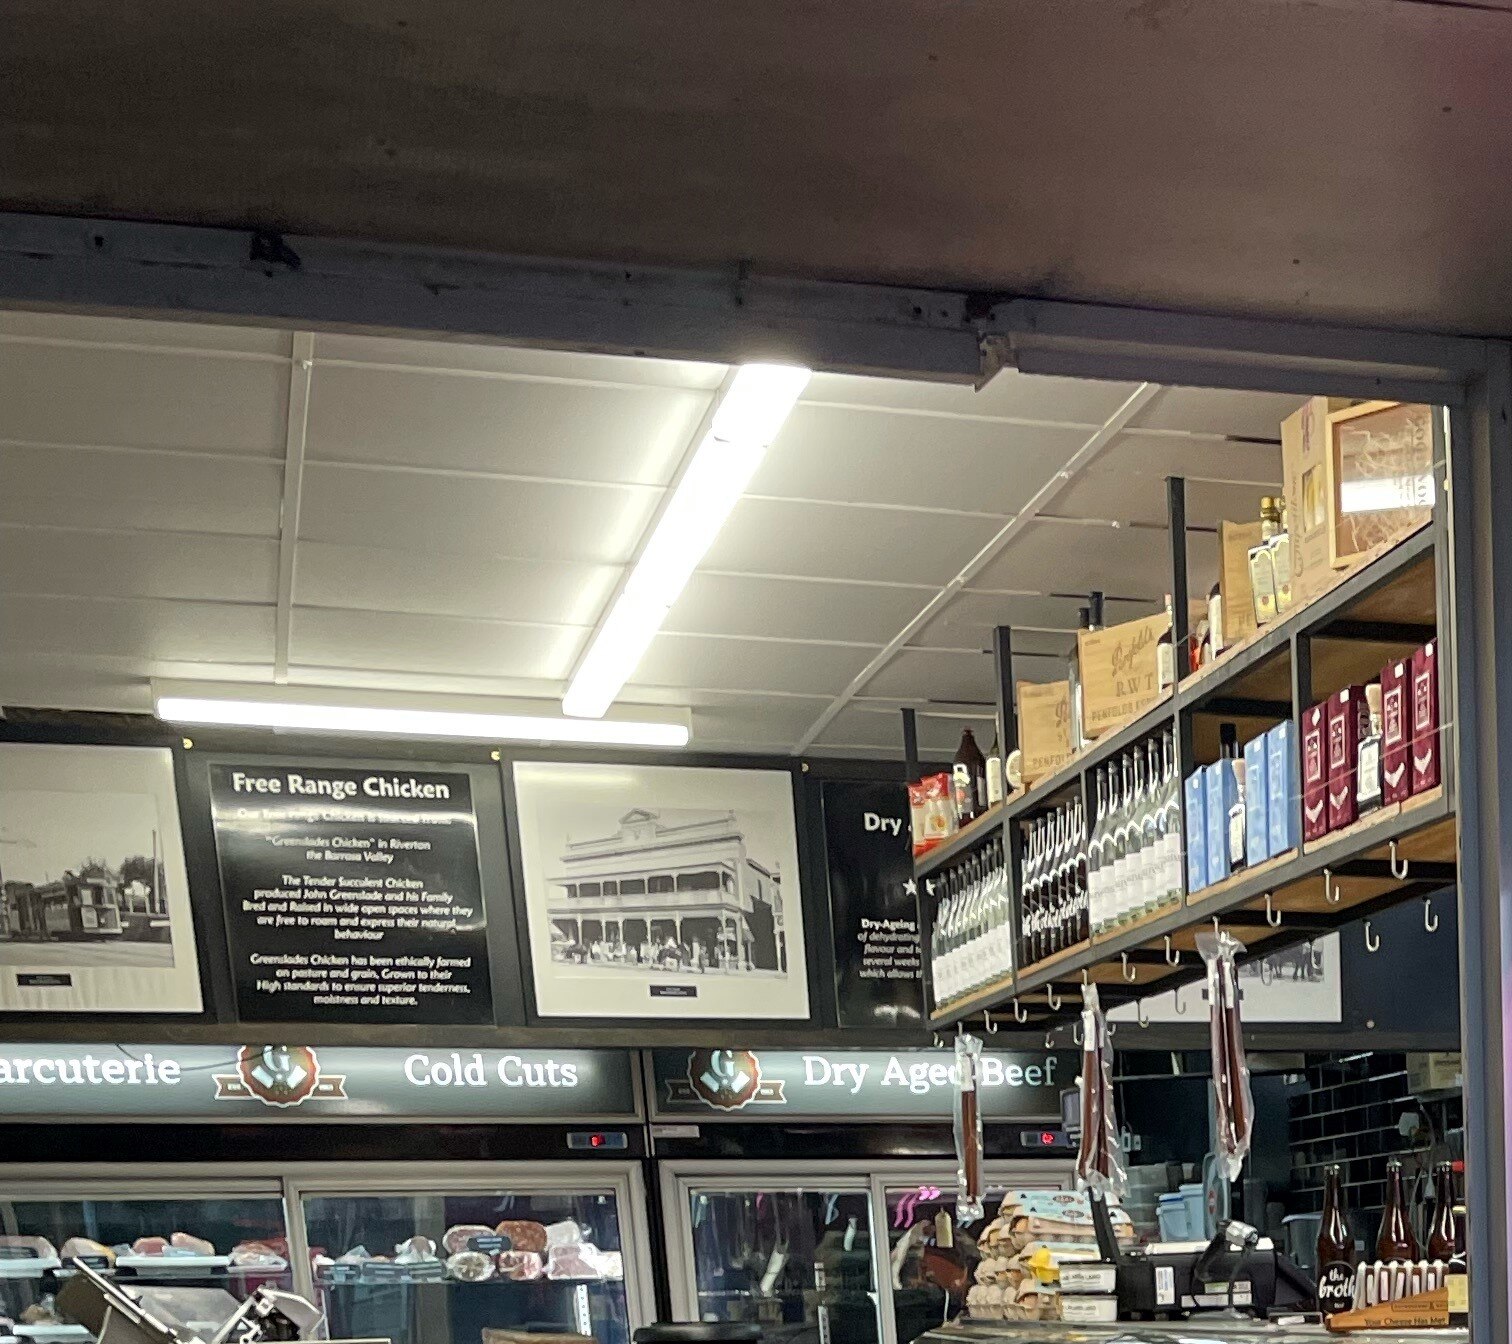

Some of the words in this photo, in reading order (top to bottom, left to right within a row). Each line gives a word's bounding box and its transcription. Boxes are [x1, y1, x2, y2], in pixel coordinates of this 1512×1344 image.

[232, 772, 281, 793] Free
[287, 774, 358, 800] Range
[363, 776, 451, 799] Chicken
[863, 811, 902, 837] Dry
[378, 838, 388, 848] in
[390, 839, 431, 850] Riverton
[306, 850, 322, 860] the
[364, 852, 394, 864] Valley
[282, 875, 301, 886] The
[303, 876, 336, 887] Tender
[338, 877, 383, 888] Succulent
[385, 877, 424, 889] Chicken
[254, 889, 301, 900] produced
[303, 889, 327, 900] John
[385, 891, 403, 902] and
[406, 892, 419, 902] his
[421, 892, 453, 905] Family
[242, 900, 266, 911] Bred
[268, 901, 287, 912] and
[289, 901, 322, 912] Raised
[323, 902, 333, 913] in
[335, 903, 359, 914] wide
[361, 904, 386, 916] open
[388, 905, 418, 917] spaces
[420, 905, 451, 916] where
[452, 905, 473, 918] they
[257, 916, 274, 926] are
[275, 914, 296, 928] free
[298, 916, 309, 927] to
[310, 917, 338, 927] roam
[339, 917, 359, 927] and
[360, 918, 394, 929] express
[396, 917, 419, 928] their
[421, 918, 456, 929] natural
[861, 918, 915, 931] Dry-Ageing
[334, 929, 384, 940] behaviour
[857, 933, 867, 943] of
[863, 944, 894, 955] flavour
[896, 944, 914, 955] and
[310, 954, 349, 966] Chicken
[351, 955, 367, 966] has
[369, 955, 394, 967] been
[395, 955, 435, 968] ethically
[863, 956, 893, 967] several
[276, 969, 290, 978] on
[292, 968, 328, 980] pasture
[329, 969, 349, 979] and
[381, 969, 415, 980] Grown
[417, 970, 428, 980] to
[430, 970, 453, 981] their
[859, 969, 885, 980] which
[887, 969, 914, 979] allows
[256, 980, 281, 994] High
[283, 981, 329, 992] standards
[332, 982, 343, 992] to
[345, 982, 376, 993] ensure
[378, 983, 416, 995] superior
[313, 995, 359, 1005] moistness
[360, 996, 380, 1006] and
[403, 1053, 487, 1087] Cold
[497, 1054, 579, 1088] Cuts
[802, 1055, 870, 1094] Dry
[979, 1057, 1057, 1087] Beef
[1329, 1267, 1345, 1282] the
